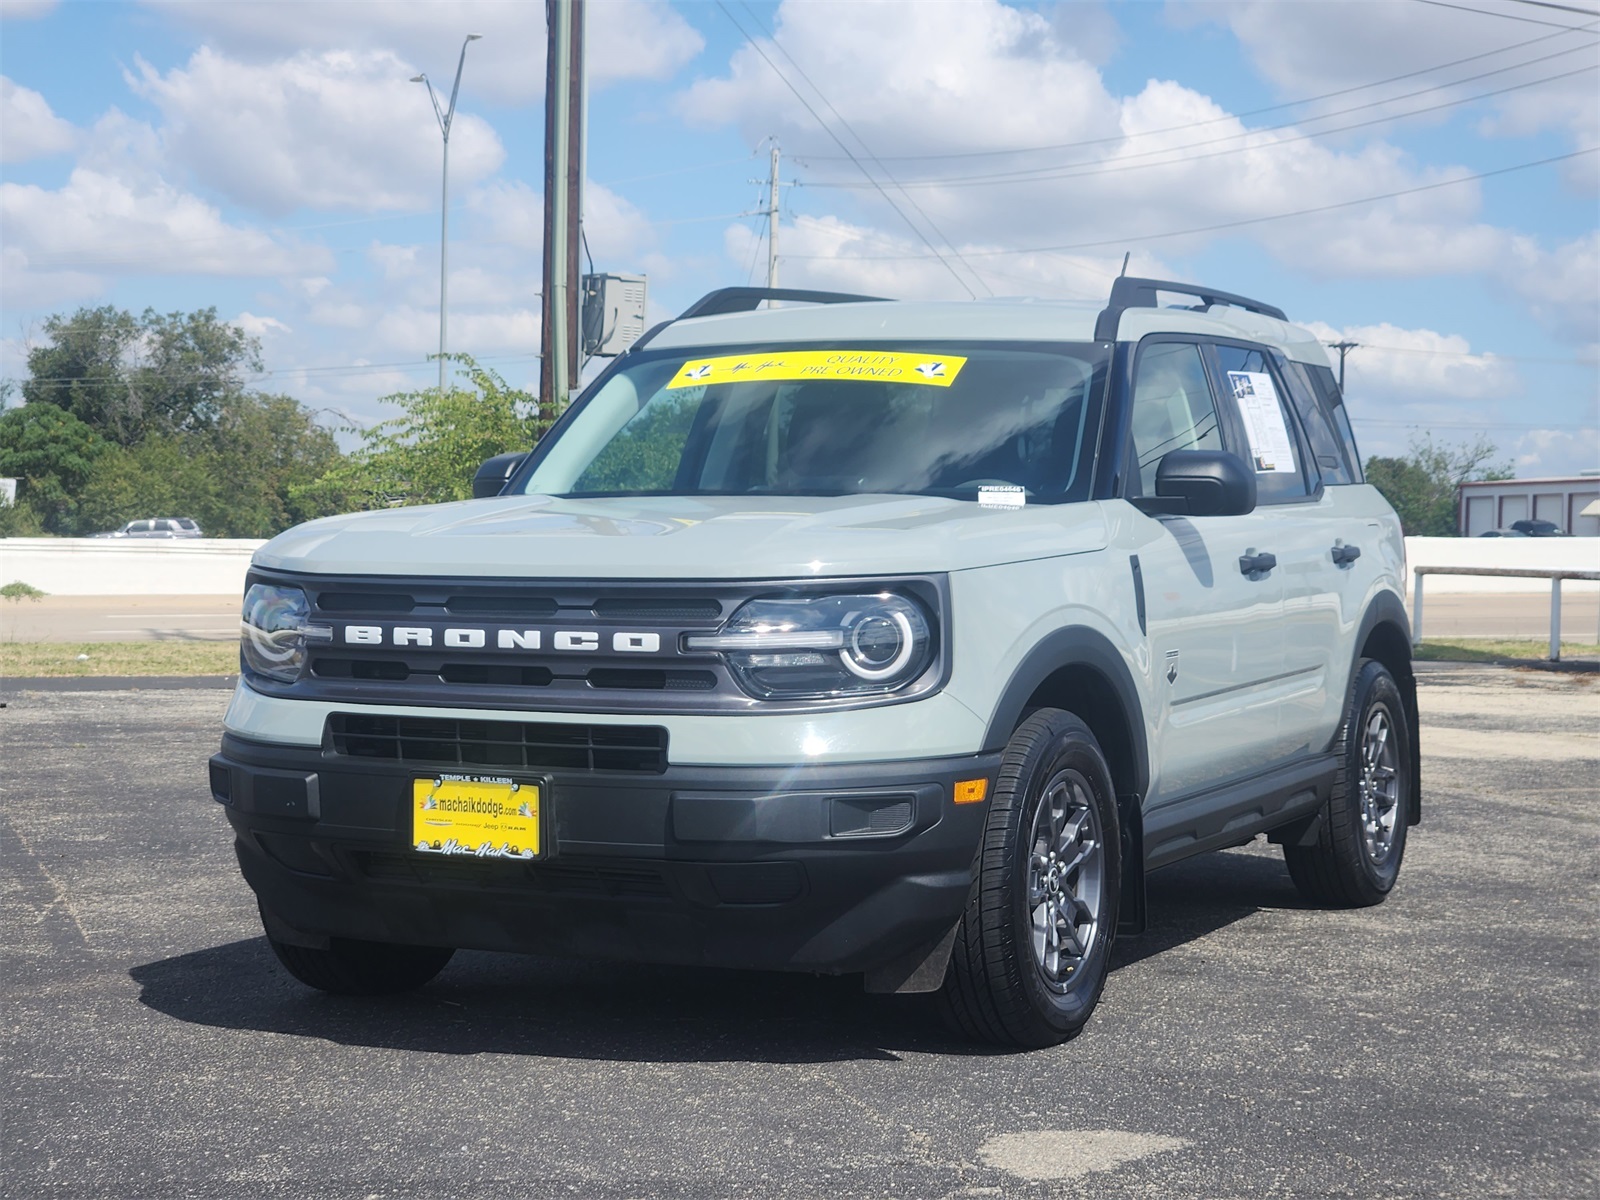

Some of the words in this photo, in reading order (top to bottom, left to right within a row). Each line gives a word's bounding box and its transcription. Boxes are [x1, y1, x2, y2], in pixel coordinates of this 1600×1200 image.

[827, 355, 901, 366] QUALITY
[800, 366, 830, 375] PRE
[836, 366, 902, 377] OWNED
[344, 626, 660, 652] BRONCO
[439, 774, 471, 782] TEMPLE
[480, 777, 513, 785] KILLEEN
[439, 796, 517, 818] machaikdodge.com
[483, 823, 499, 831] Jeep
[440, 838, 470, 856] Mac
[474, 841, 511, 858] Haik
